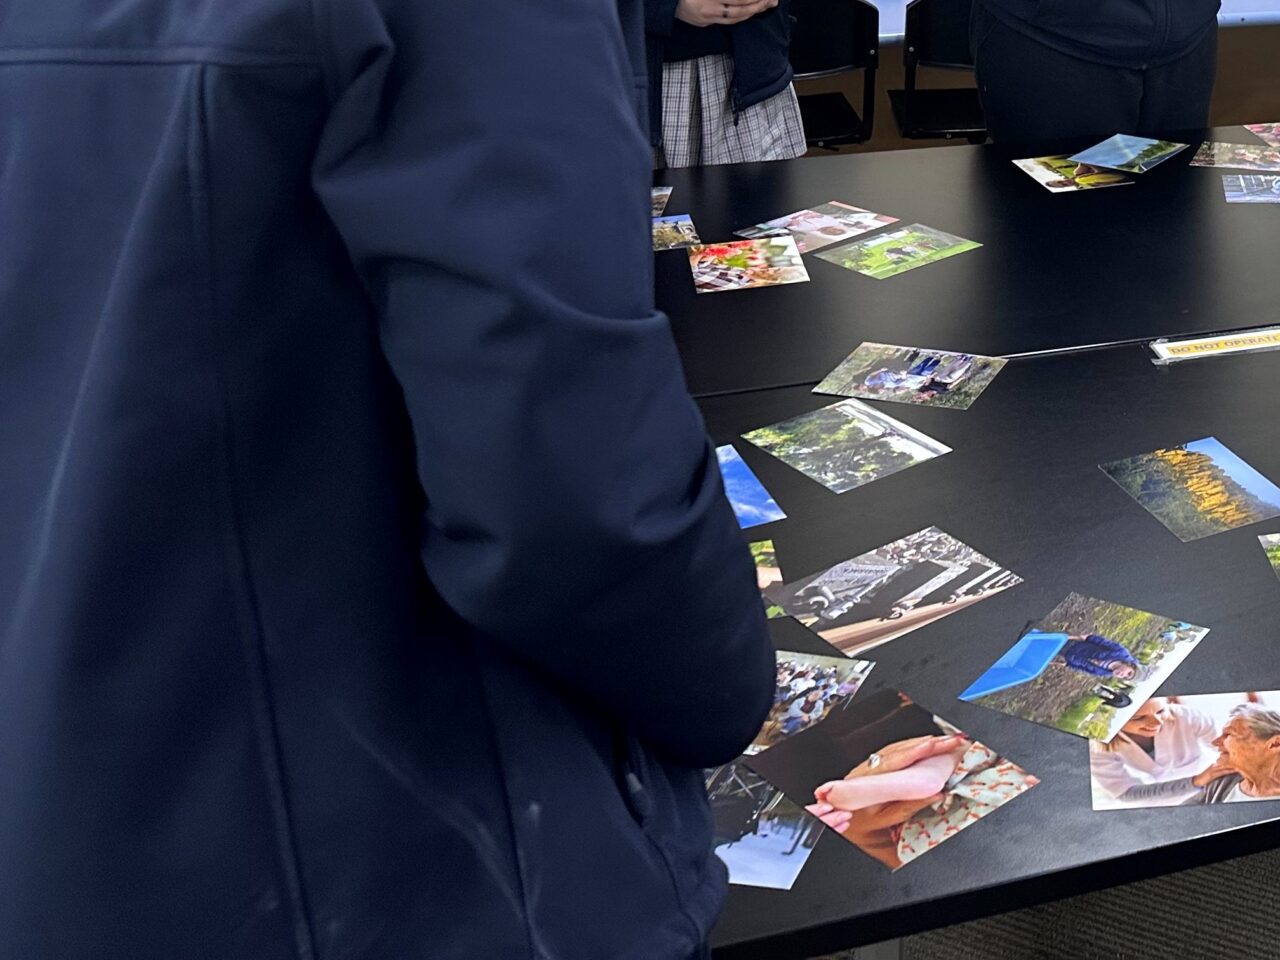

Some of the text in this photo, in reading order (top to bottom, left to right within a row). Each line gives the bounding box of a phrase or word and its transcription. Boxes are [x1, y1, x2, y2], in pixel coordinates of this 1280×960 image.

[1171, 346, 1191, 355] DO
[1194, 342, 1222, 352] NOT
[1224, 335, 1277, 347] OPERATE
